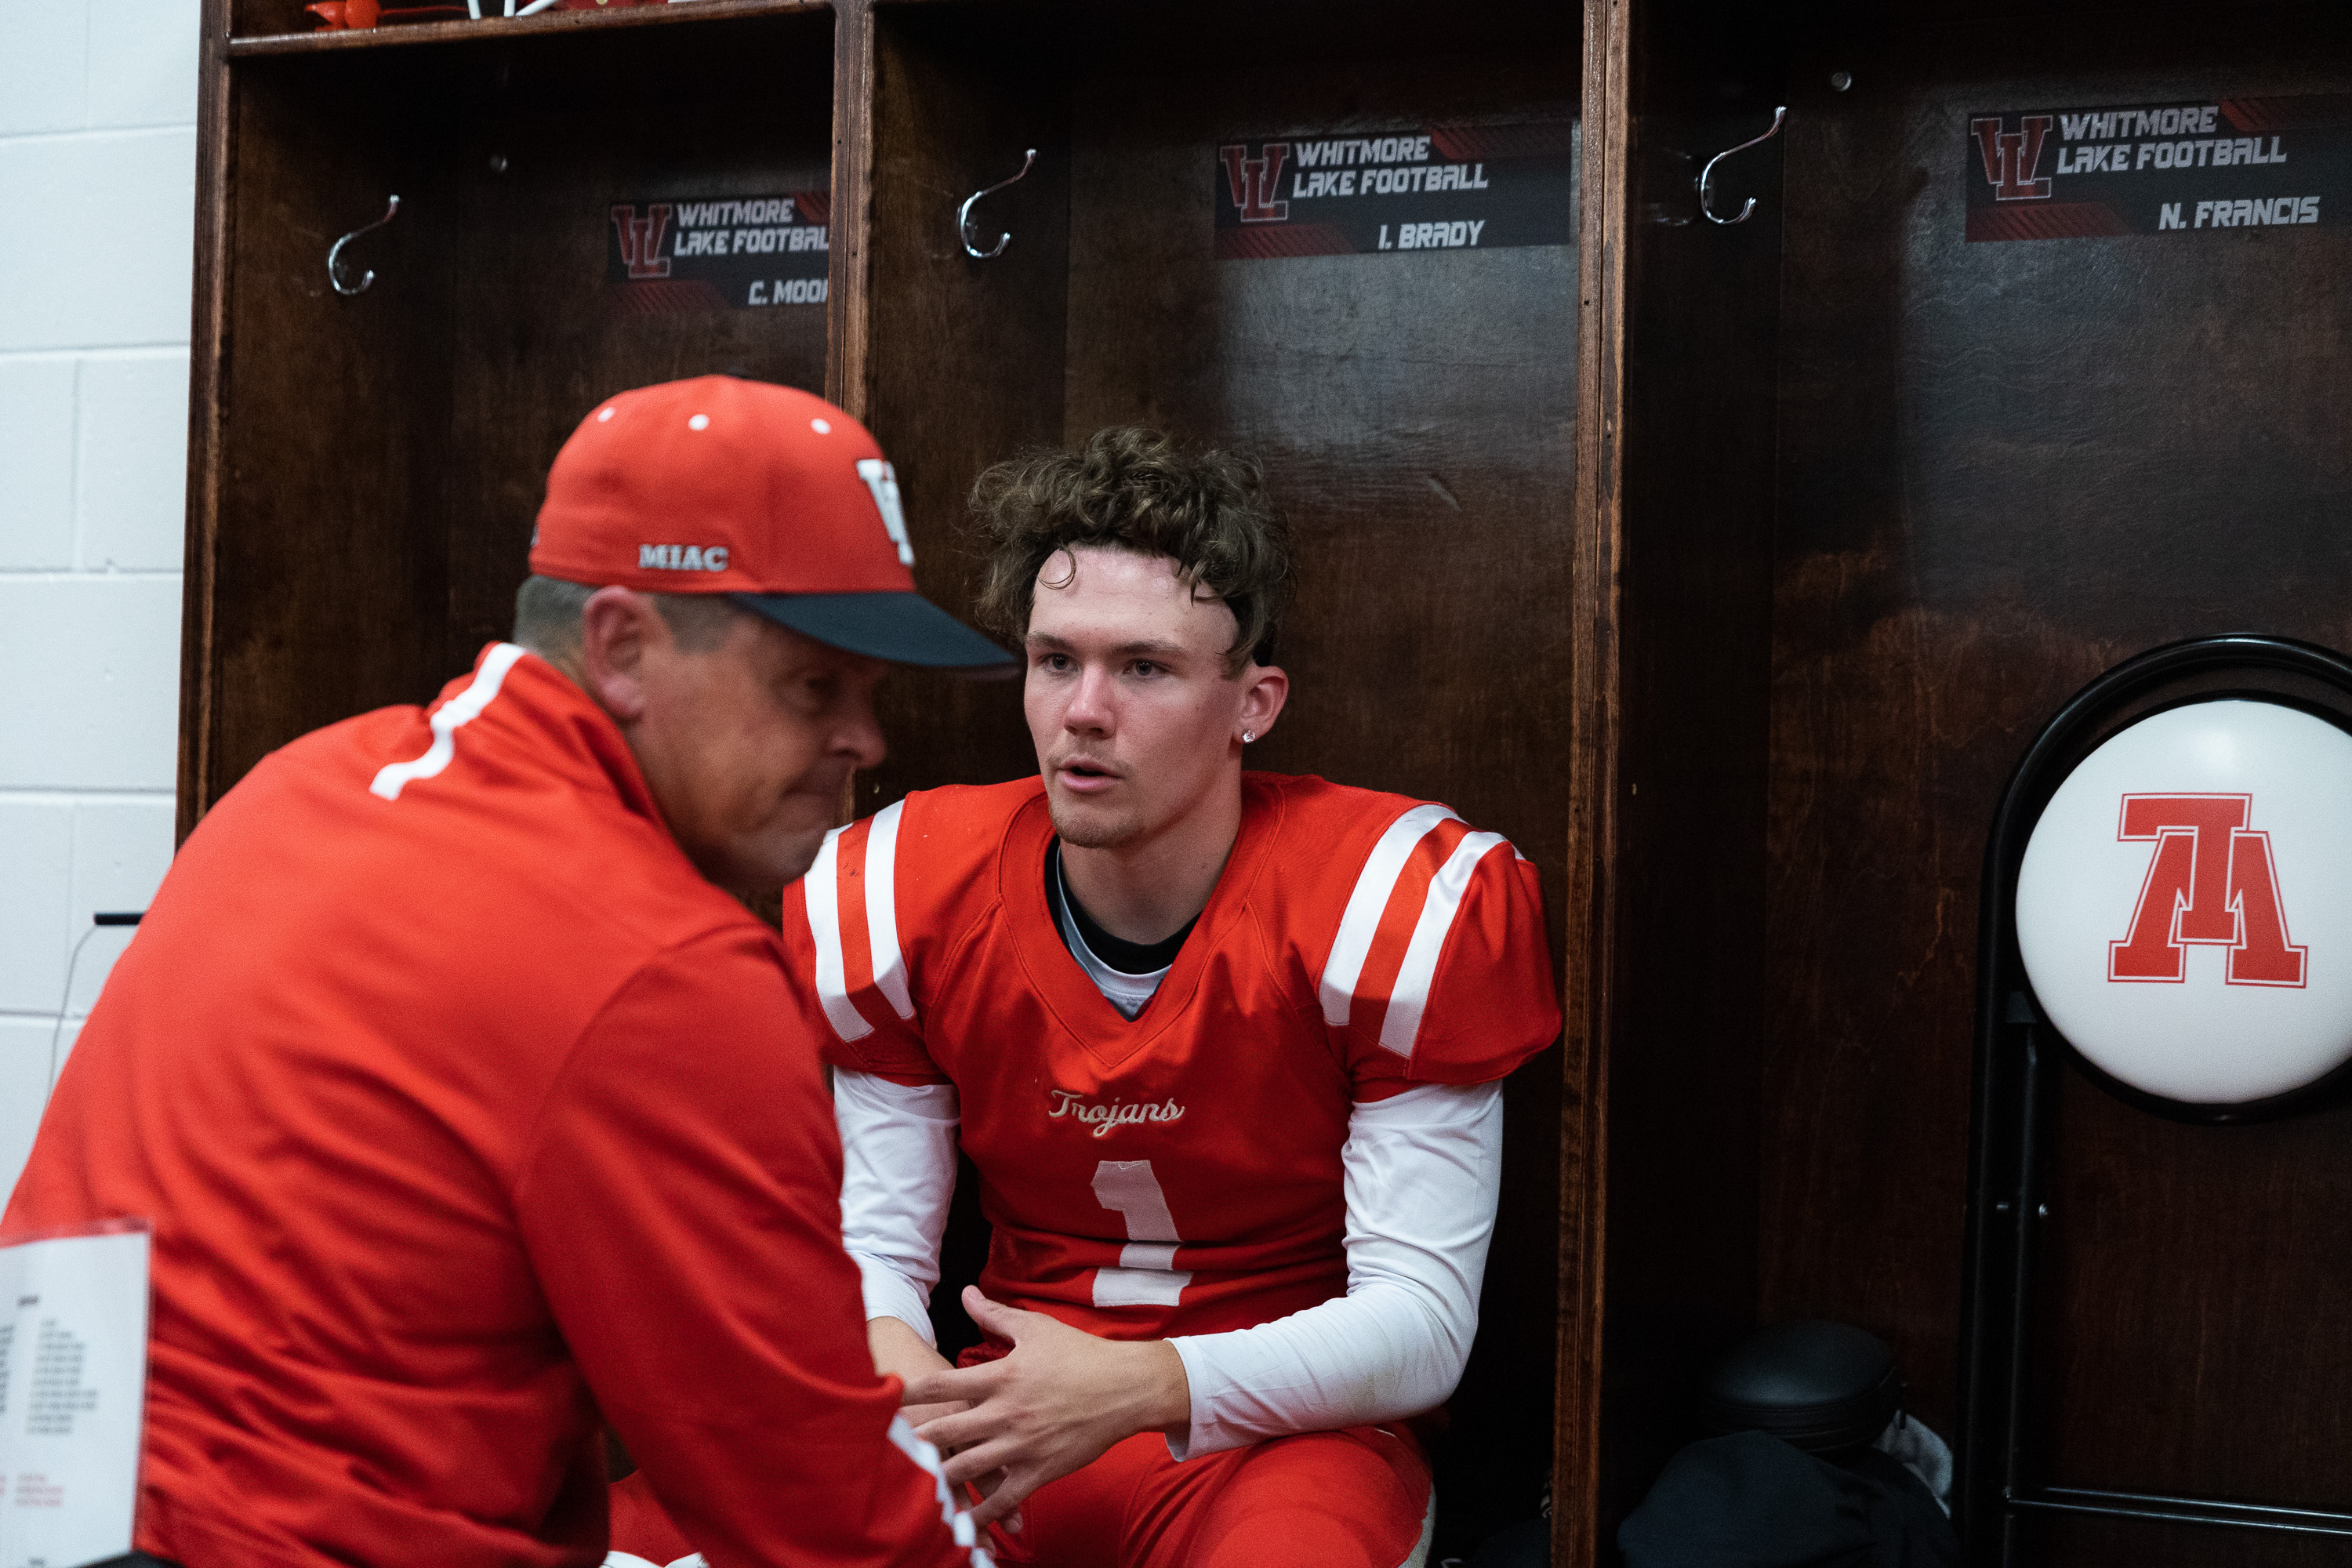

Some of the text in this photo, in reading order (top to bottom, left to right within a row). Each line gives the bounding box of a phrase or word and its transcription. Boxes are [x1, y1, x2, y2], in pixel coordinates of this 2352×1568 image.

[2059, 105, 2220, 141] WHITMORE
[1294, 135, 1432, 168] WHITMORE
[2056, 136, 2287, 175] LAKE FOOTBALL
[1291, 162, 1489, 198] LAKE FOOTBALL
[677, 198, 796, 227] WHITMORE
[2158, 196, 2321, 230] N. FRANCIS
[673, 225, 829, 257] LAKE FOOTBAL
[1377, 220, 1486, 250] I. BRADY
[748, 279, 768, 305] C.
[638, 543, 729, 572] MIAC
[1048, 1089, 1185, 1138] Trojans
[1090, 1160, 1194, 1308] 1
